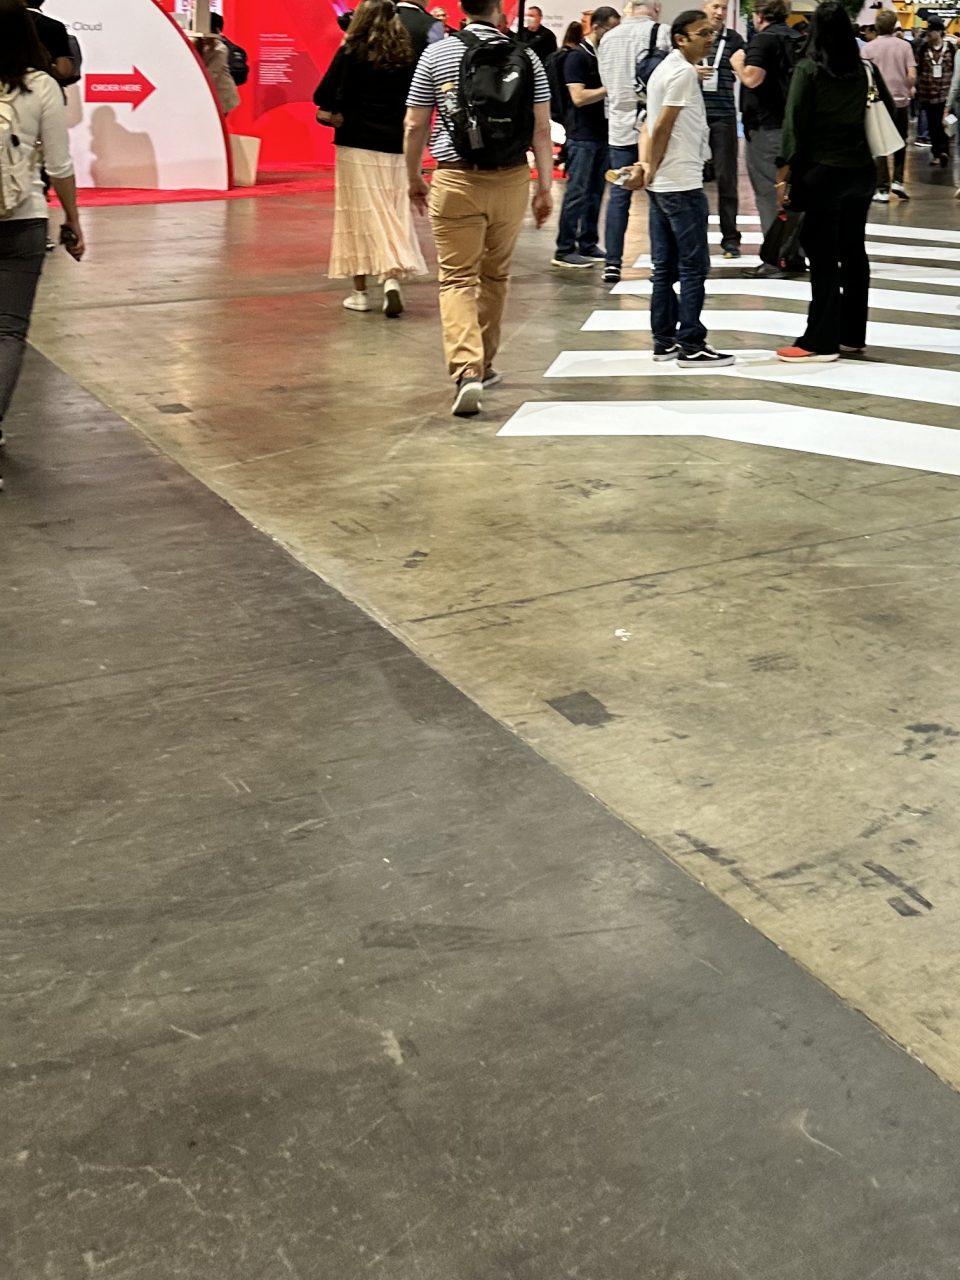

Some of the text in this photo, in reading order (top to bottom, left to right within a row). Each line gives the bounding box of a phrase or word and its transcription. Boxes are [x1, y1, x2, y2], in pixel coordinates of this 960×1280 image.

[72, 21, 103, 31] Cloud
[91, 83, 142, 93] ORDER HERE
